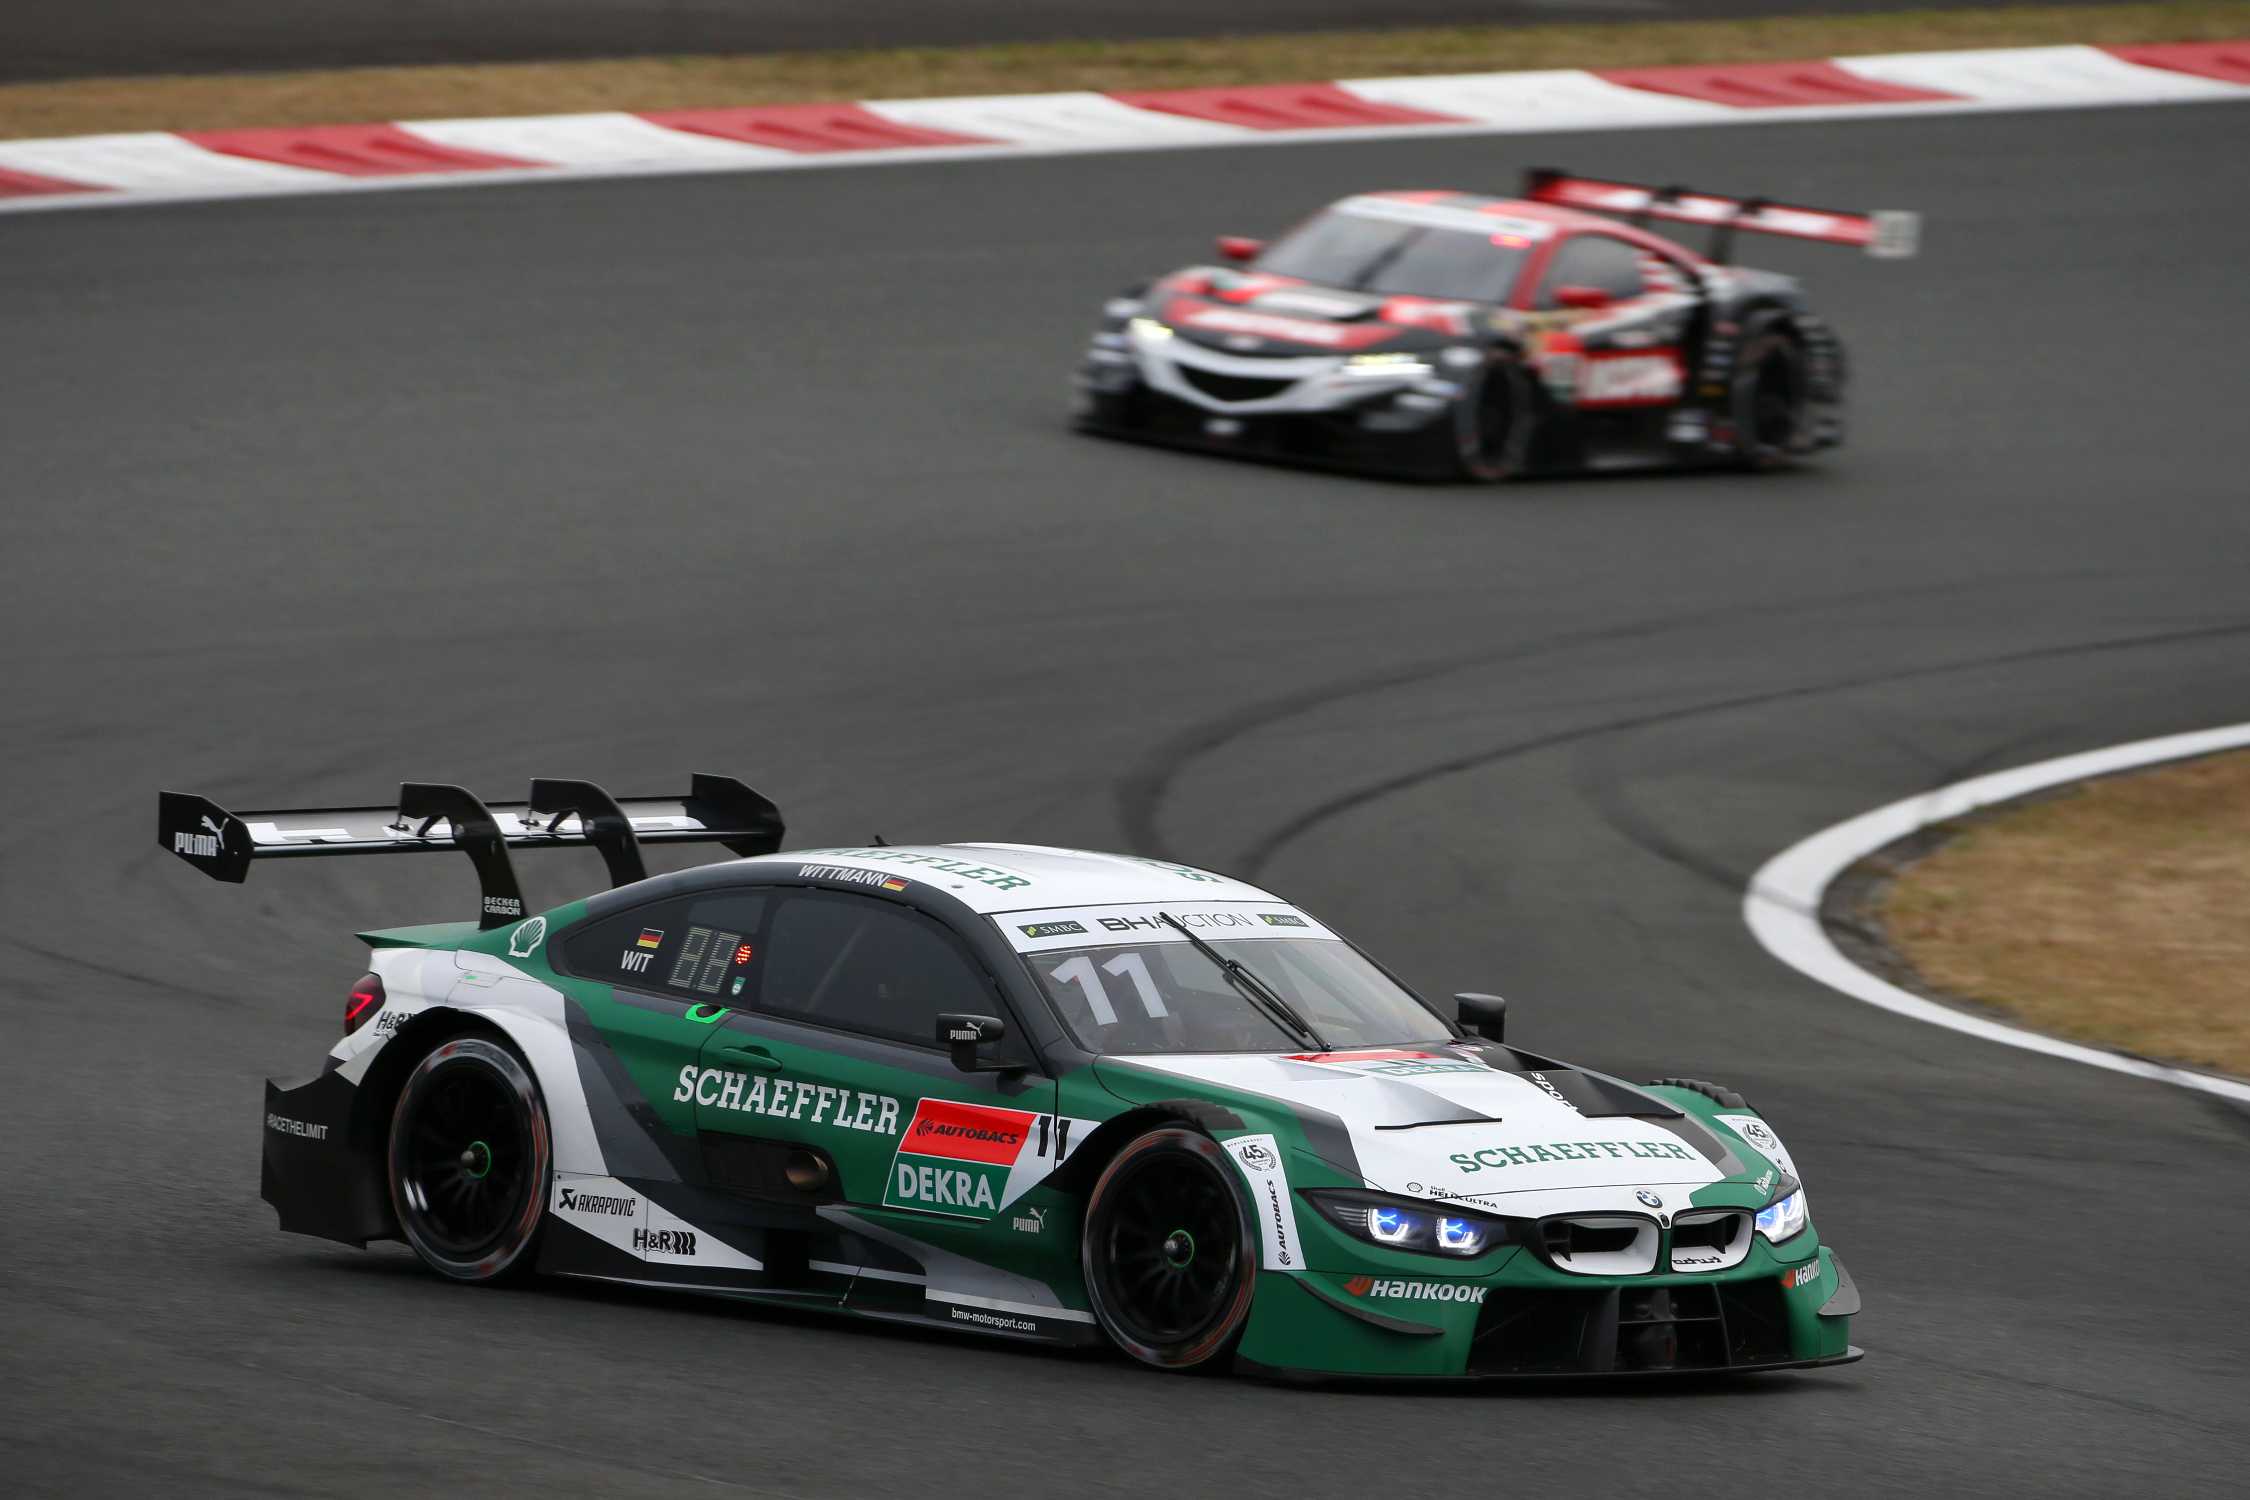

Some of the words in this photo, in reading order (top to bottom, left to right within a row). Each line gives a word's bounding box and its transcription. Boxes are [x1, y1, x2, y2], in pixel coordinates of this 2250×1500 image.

[174, 831, 217, 857] PUMA
[798, 864, 890, 888] WITTMANN
[620, 950, 654, 973] WIT
[1050, 953, 1169, 1026] 11
[950, 1029, 977, 1041] PUMA
[673, 1064, 900, 1136] SCHAEFFLER
[935, 1123, 1019, 1145] AUTOBACS
[1036, 1115, 1072, 1161] 11
[1450, 1141, 1697, 1174] SCHAEFFLER
[897, 1163, 996, 1211] DEKRA
[1012, 1216, 1040, 1234] PUMA
[1266, 1178, 1287, 1251] AUTOBACS
[951, 1307, 1036, 1332] bmw-motorsport.com
